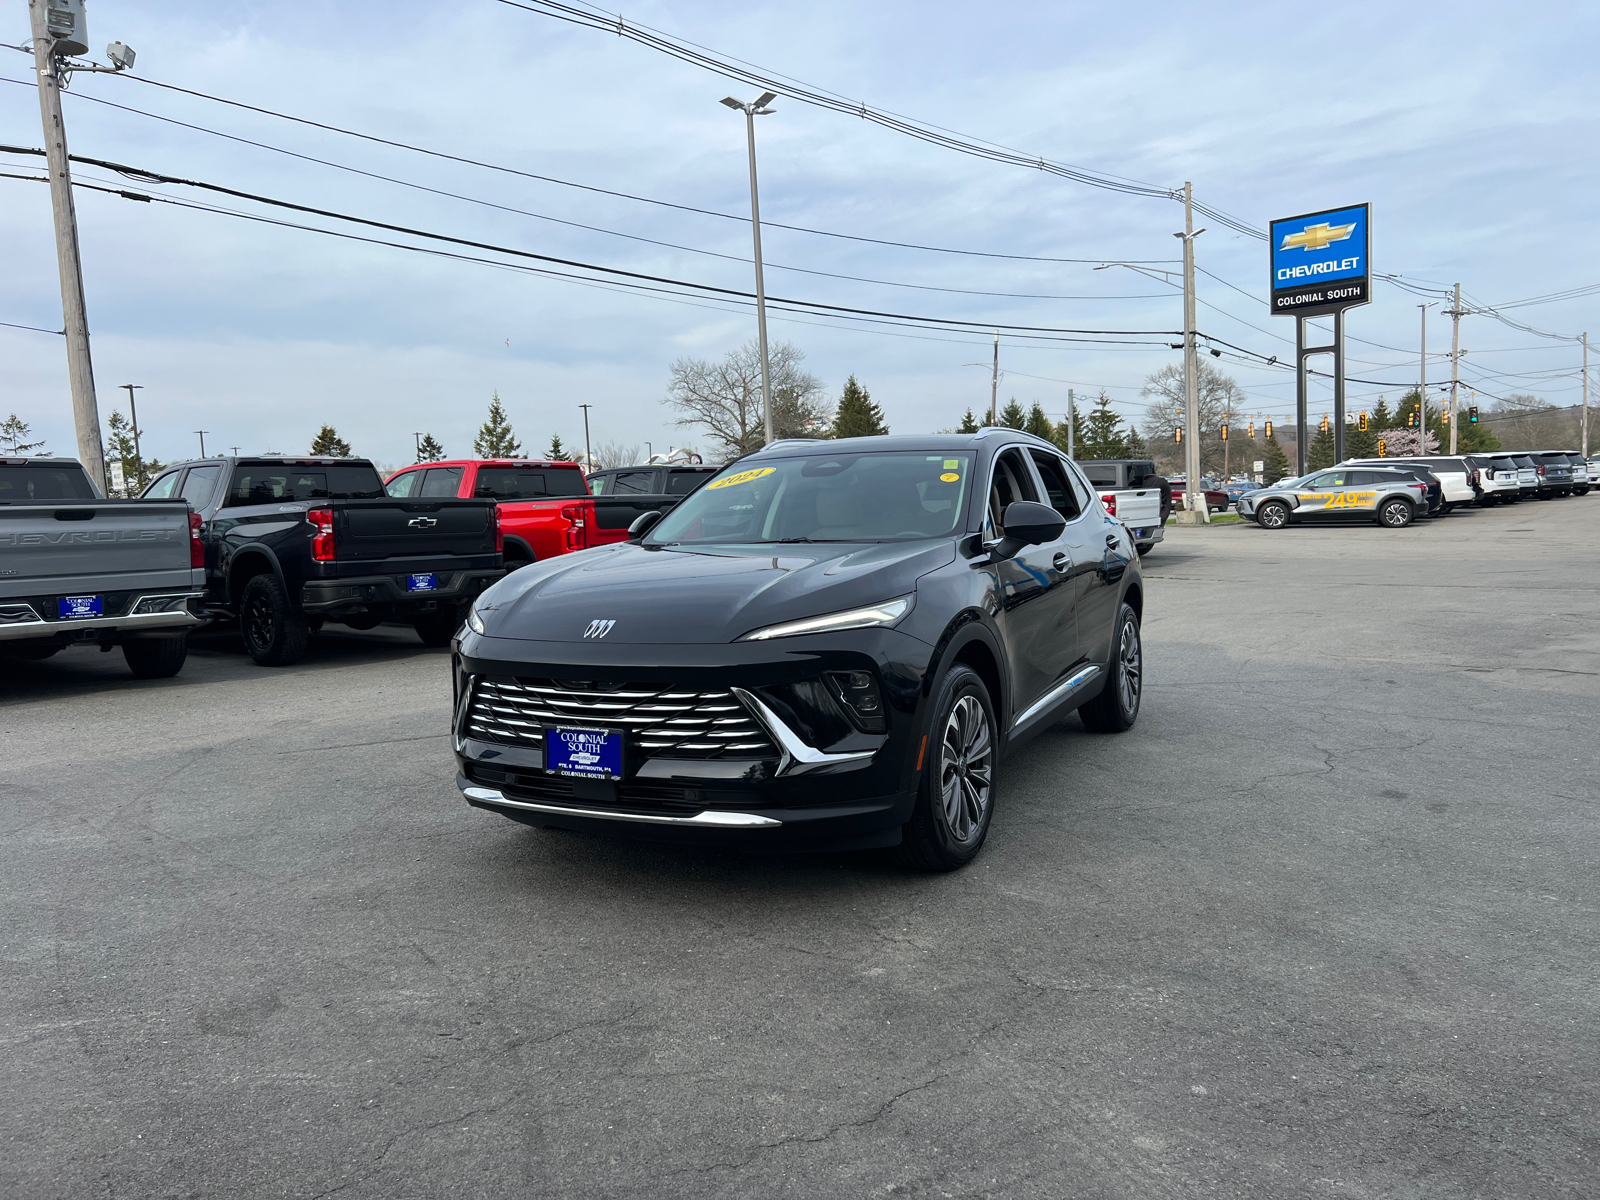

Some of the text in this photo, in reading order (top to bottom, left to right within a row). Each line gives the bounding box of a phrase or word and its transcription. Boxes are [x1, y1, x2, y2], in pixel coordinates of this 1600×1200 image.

[1277, 256, 1359, 280] CHEVROLET
[1277, 286, 1360, 307] COLONIAL SOUTH
[715, 469, 766, 488] 2024
[0, 529, 176, 545] HEVROLET
[561, 732, 607, 745] COLONIAL
[568, 742, 600, 753] SOUTH
[587, 772, 606, 780] SOUTH
